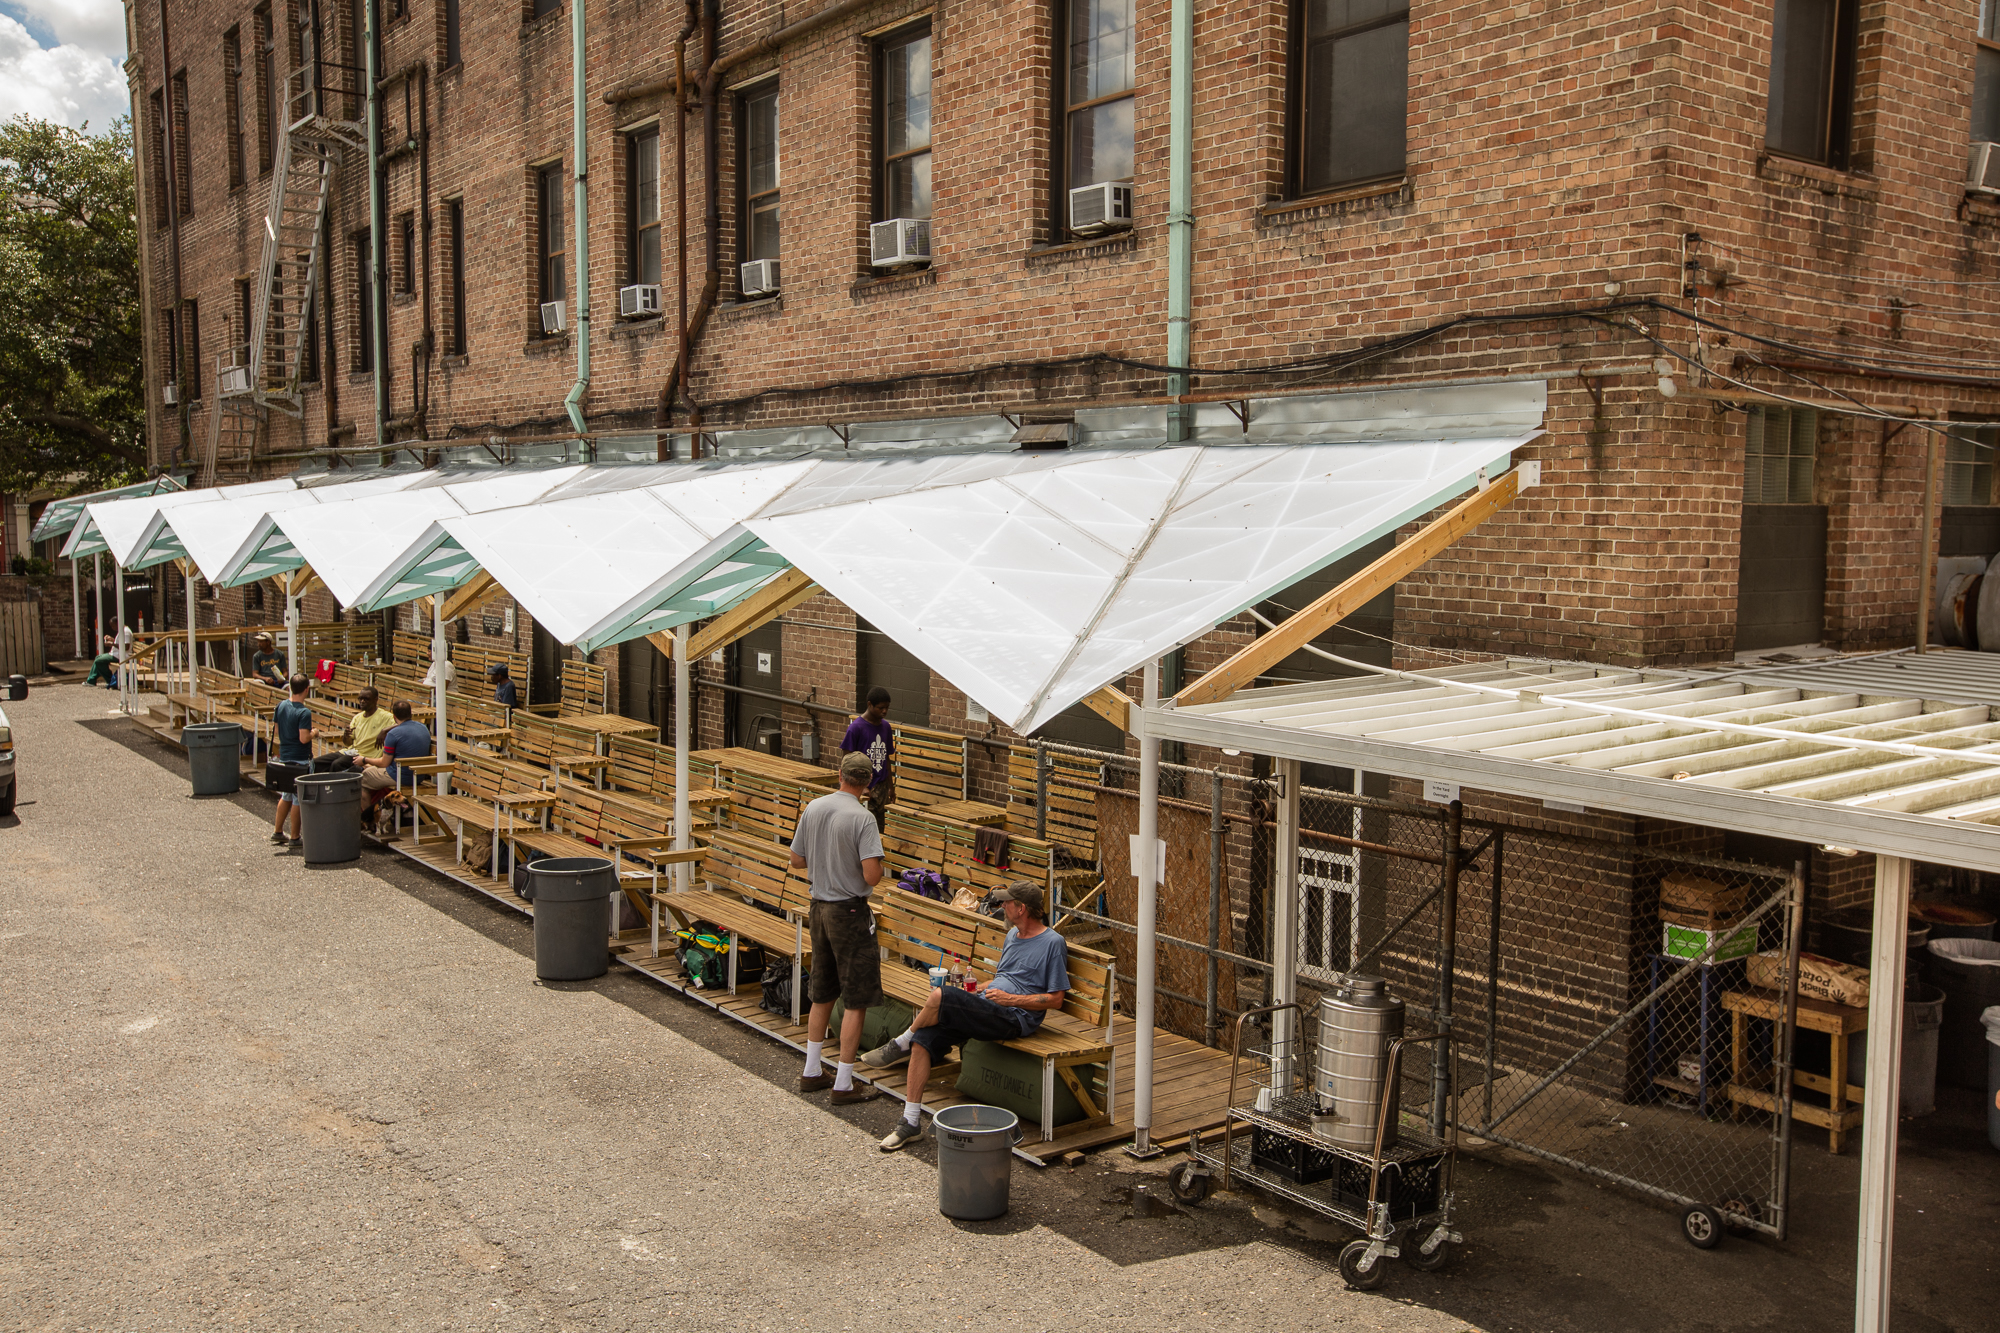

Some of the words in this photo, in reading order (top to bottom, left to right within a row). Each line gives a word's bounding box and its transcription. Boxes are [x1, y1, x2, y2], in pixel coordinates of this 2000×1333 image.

[1432, 791, 1449, 799] Overnight
[1800, 981, 1829, 998] Black
[947, 1133, 974, 1144] BRUTE
